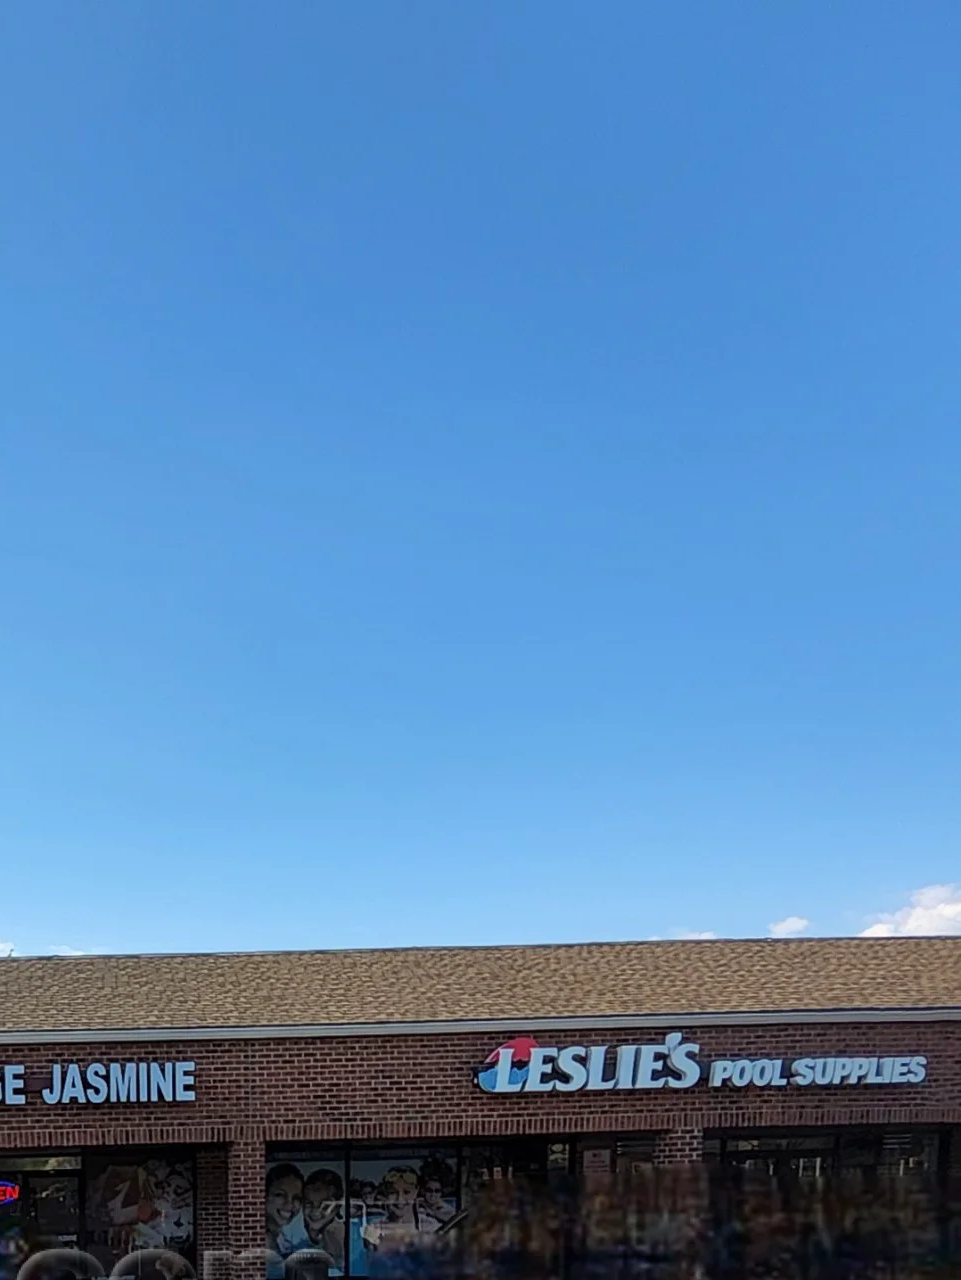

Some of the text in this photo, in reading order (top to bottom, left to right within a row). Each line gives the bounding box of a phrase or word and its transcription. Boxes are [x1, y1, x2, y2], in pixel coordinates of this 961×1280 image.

[41, 1060, 197, 1105] JASMINE
[494, 1031, 929, 1093] LESLIE'S POOL SUPPLIES
